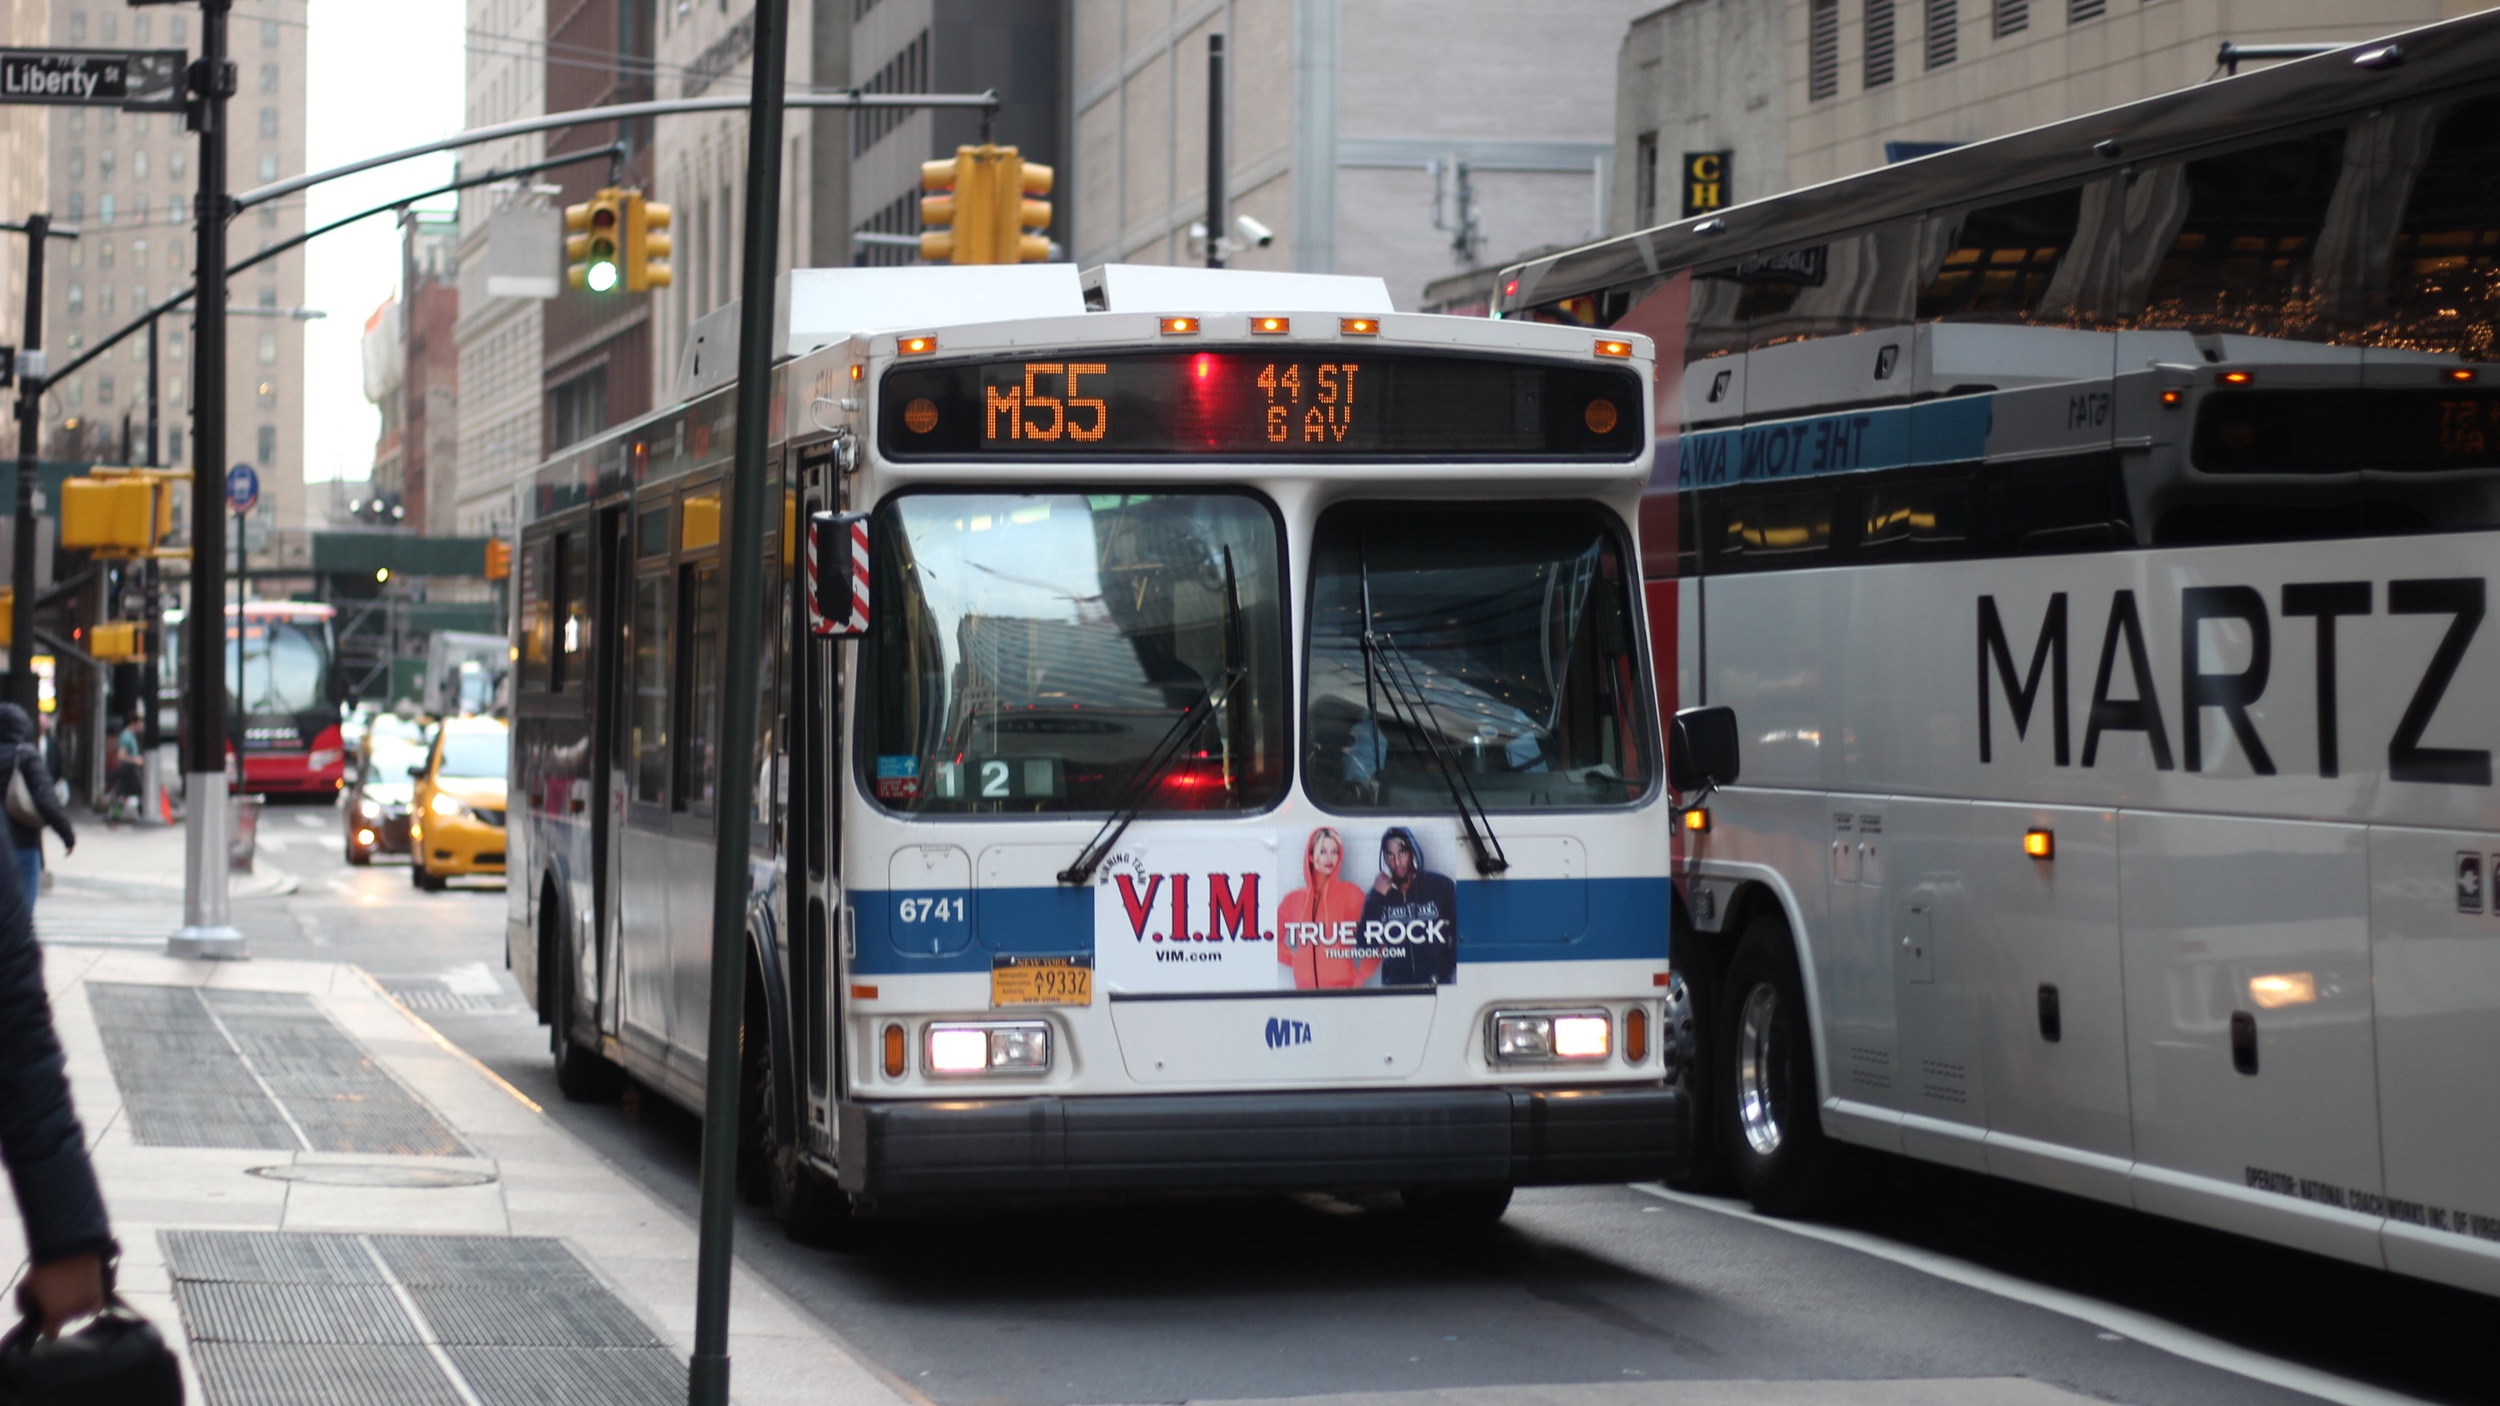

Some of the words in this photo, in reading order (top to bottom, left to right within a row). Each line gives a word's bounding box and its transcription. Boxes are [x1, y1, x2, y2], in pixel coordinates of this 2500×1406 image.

[6, 63, 98, 100] Liberty
[104, 65, 119, 83] St
[1691, 155, 1720, 215] CH
[1257, 364, 1300, 404] 44
[1318, 364, 1359, 404] ST
[987, 363, 1107, 442] M55
[1267, 406, 1287, 442] 6
[1304, 406, 1350, 442] AV
[1977, 577, 2492, 787] MARTZ
[981, 760, 1011, 797] 2
[900, 897, 964, 923] 6741
[1284, 920, 1358, 947] TRUE
[1364, 919, 1447, 945] ROCK
[1156, 950, 1222, 962] VIM.com
[1325, 947, 1406, 958] TRUEROCK.COM
[1046, 970, 1087, 995] 9332
[1265, 1016, 1312, 1050] MTA
